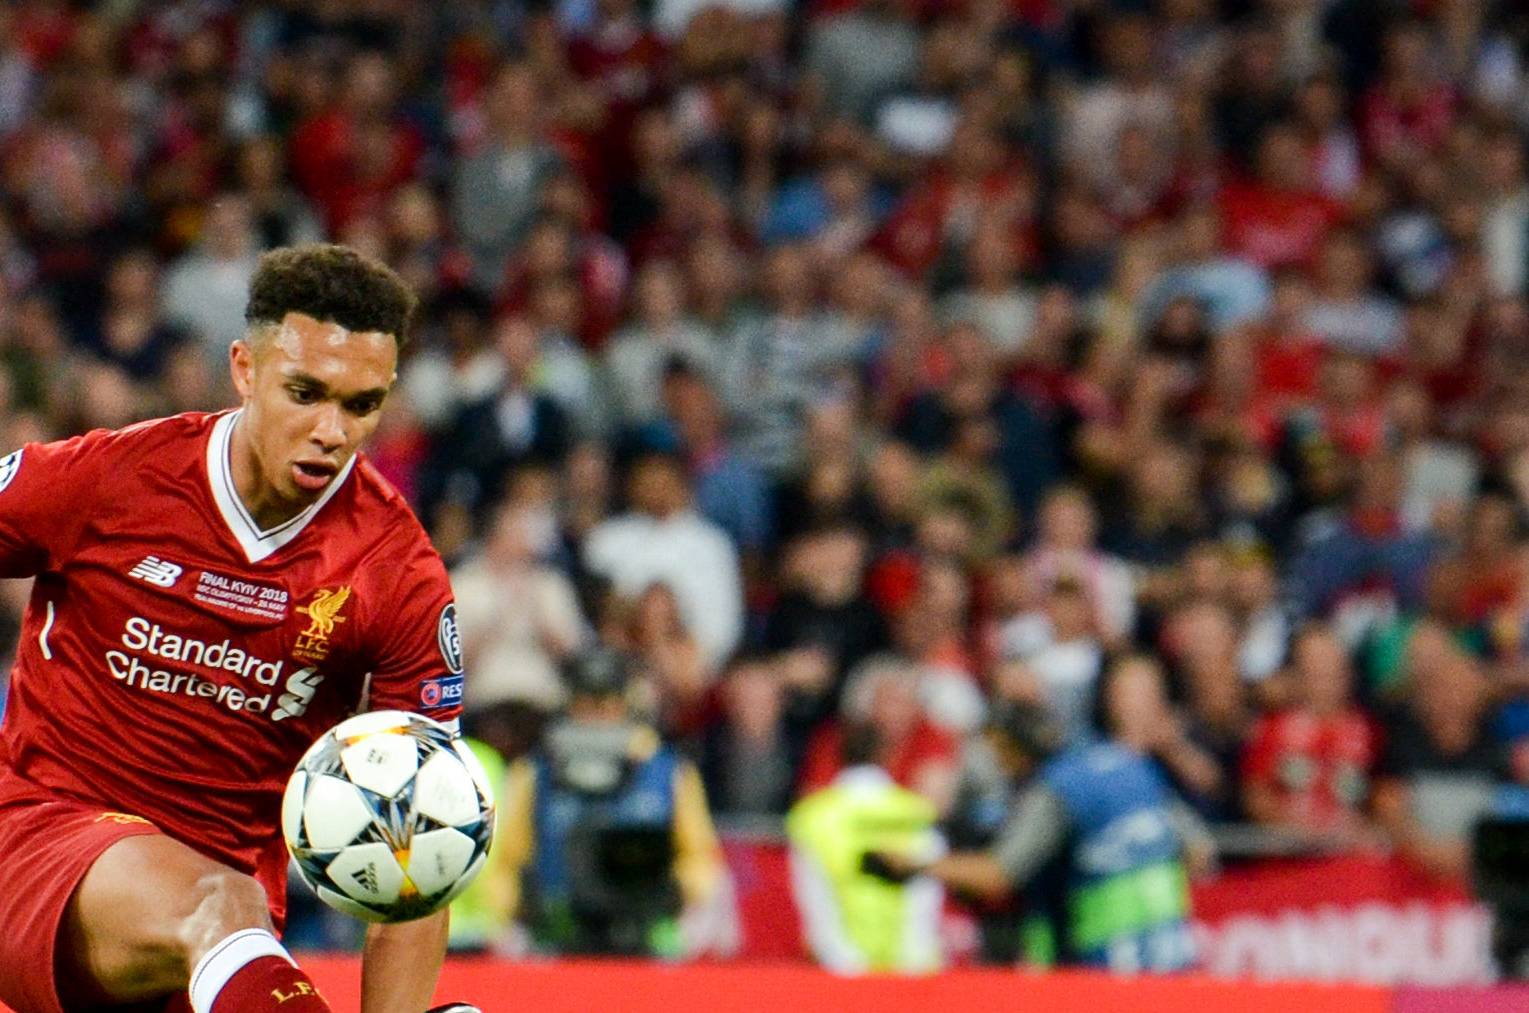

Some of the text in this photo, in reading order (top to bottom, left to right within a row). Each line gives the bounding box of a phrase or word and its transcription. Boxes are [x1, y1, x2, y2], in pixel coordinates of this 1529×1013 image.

[199, 571, 230, 589] FINAL
[231, 580, 260, 596] KYIV
[258, 587, 288, 603] 2018
[105, 650, 272, 713] Chartered
[121, 616, 283, 687] Standard
